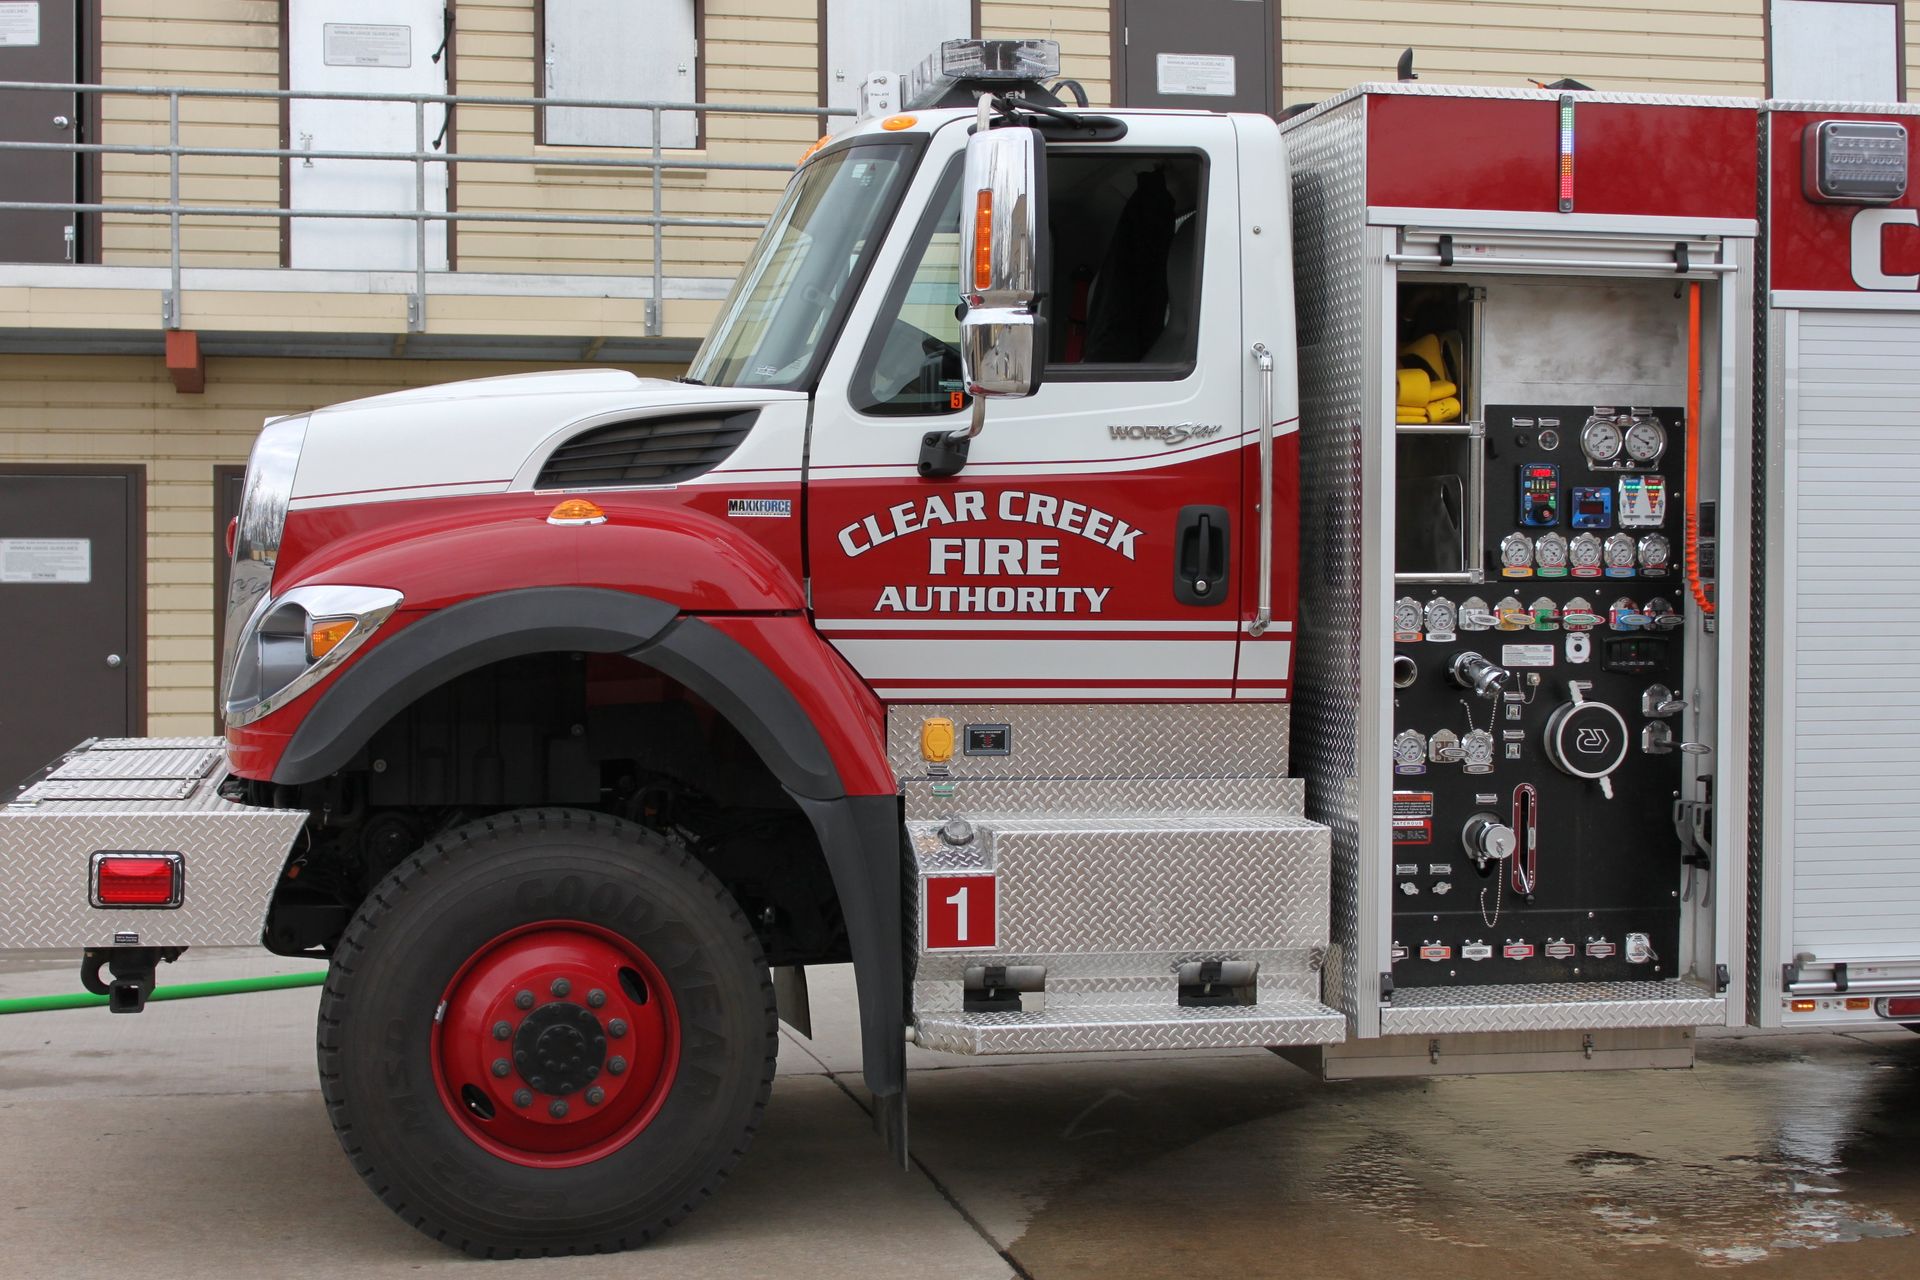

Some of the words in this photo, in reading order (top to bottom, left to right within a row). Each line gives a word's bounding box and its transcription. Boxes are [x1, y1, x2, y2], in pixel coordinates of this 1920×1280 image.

[728, 500, 790, 512] MAXXFORCE
[837, 489, 988, 558] CLEAR
[997, 489, 1145, 561] CREEK
[928, 537, 1061, 576] FIRE
[873, 585, 1110, 613] AUTHORITY
[946, 887, 968, 941] 1
[514, 875, 727, 1098] GOODYEAR
